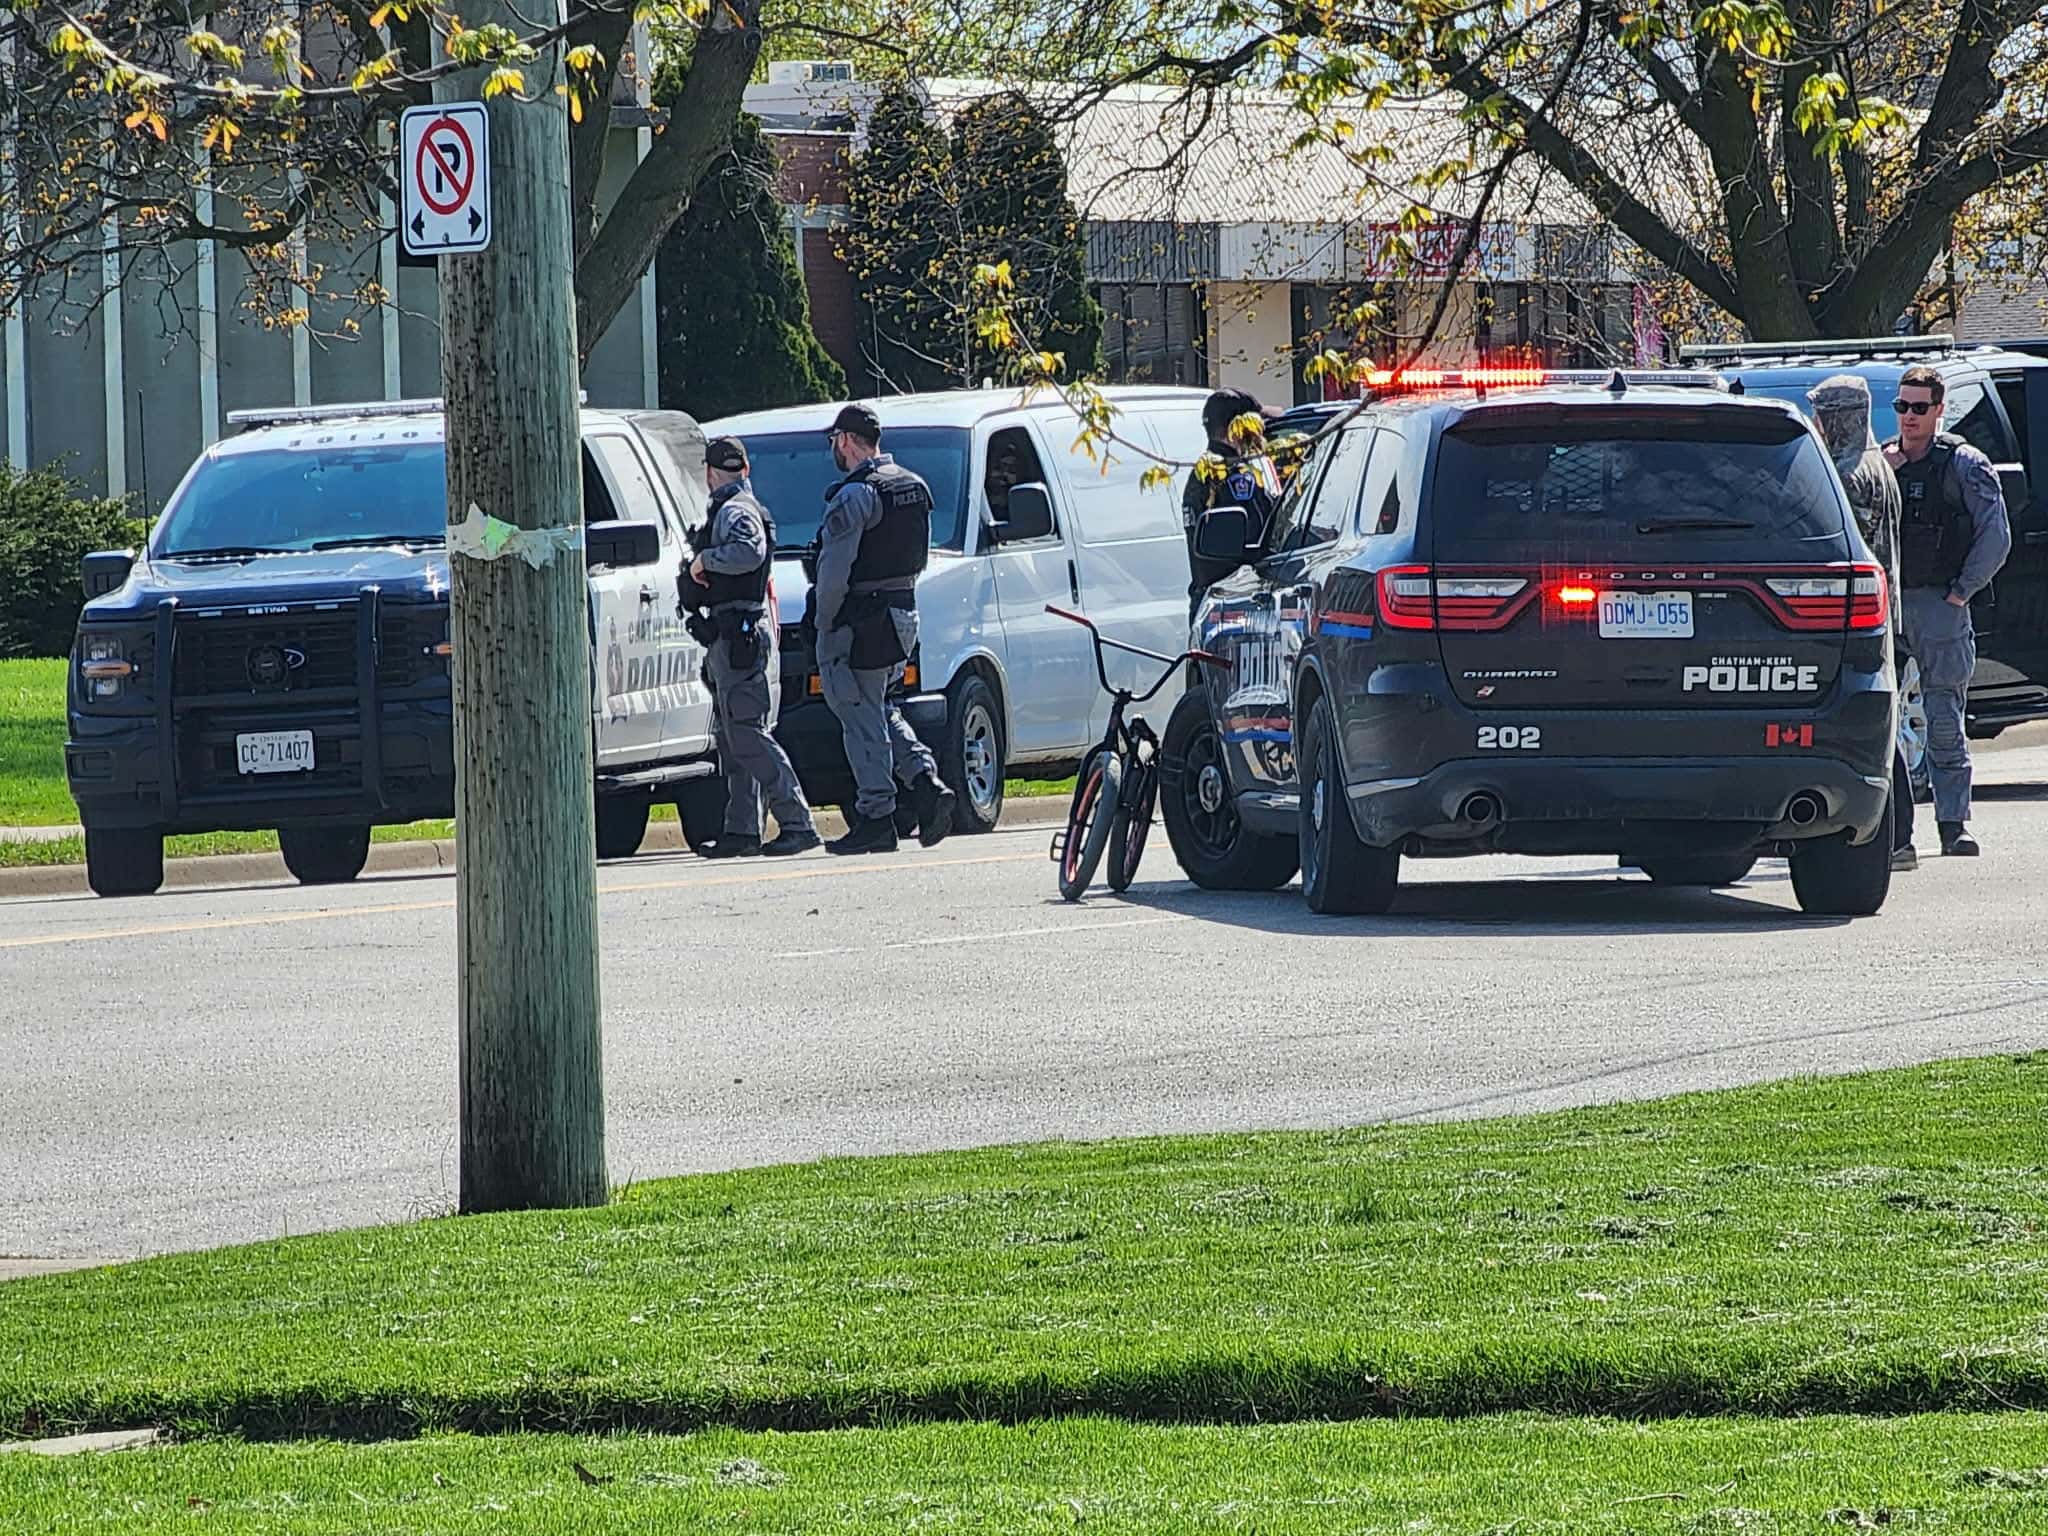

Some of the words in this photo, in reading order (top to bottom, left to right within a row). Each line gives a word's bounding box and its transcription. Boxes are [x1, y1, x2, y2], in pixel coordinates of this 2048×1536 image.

[1578, 572, 1716, 580] DODGE
[1657, 602, 1689, 625] 055
[1682, 665, 1819, 692] POLICE
[1477, 726, 1541, 749] 202
[267, 740, 309, 762] 71407
